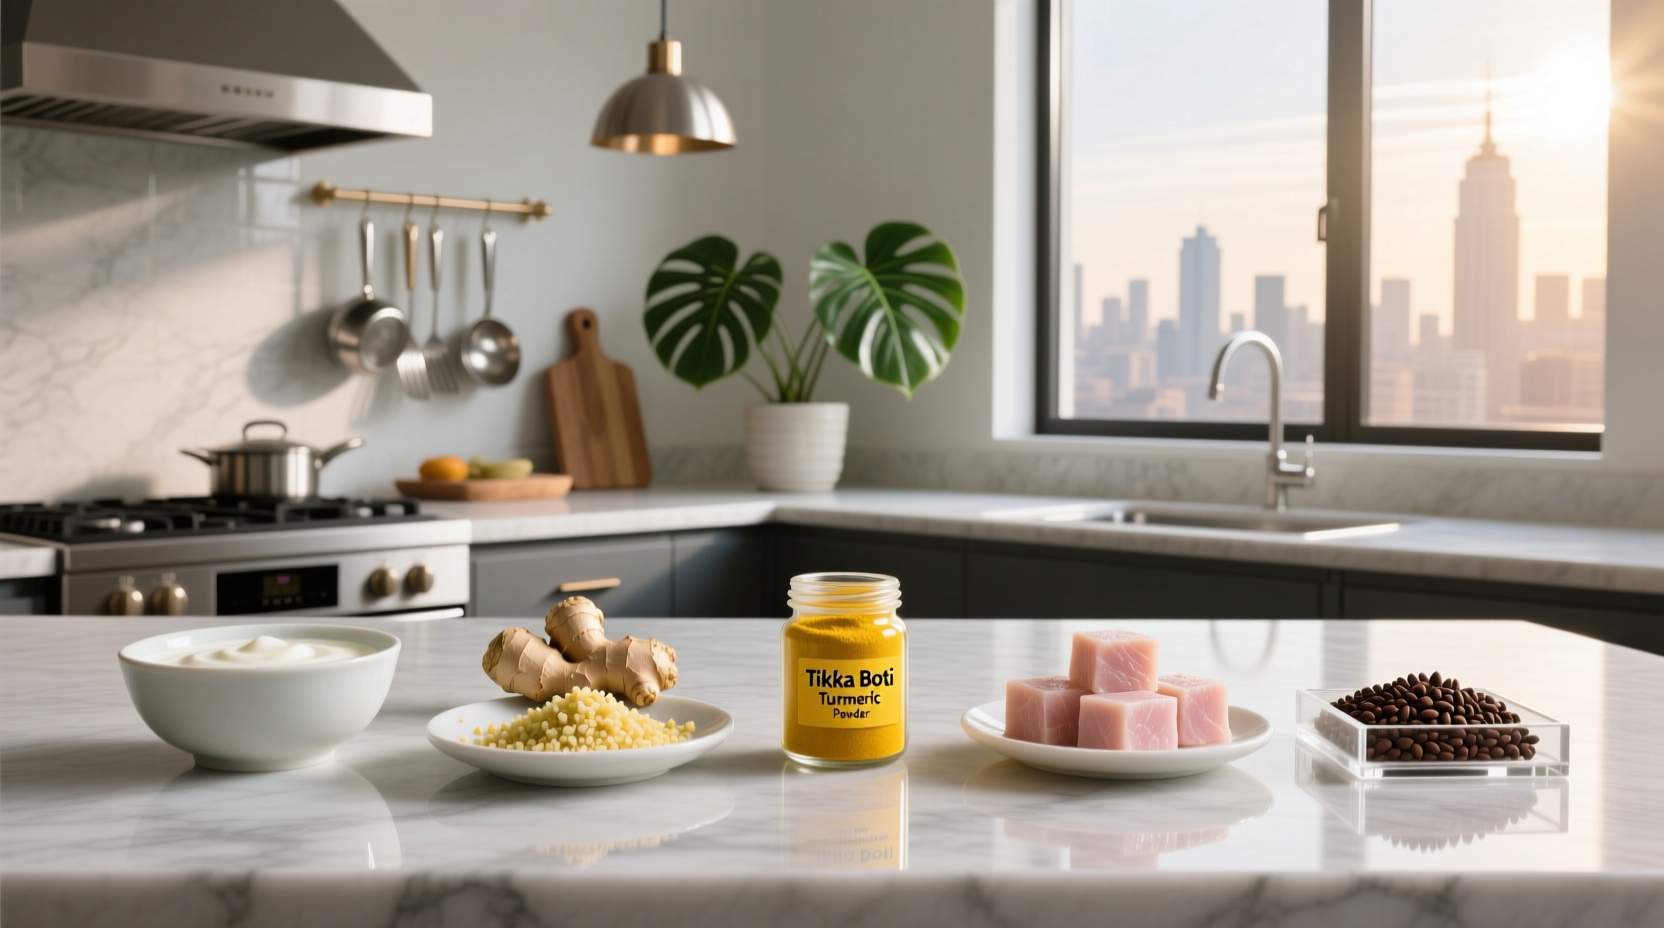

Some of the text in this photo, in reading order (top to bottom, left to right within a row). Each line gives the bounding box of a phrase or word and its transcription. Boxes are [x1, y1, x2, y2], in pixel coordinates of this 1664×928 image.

[805, 667, 894, 688] Tikka Boti
[818, 690, 881, 706] Turmeric
[833, 707, 871, 719] Powder
